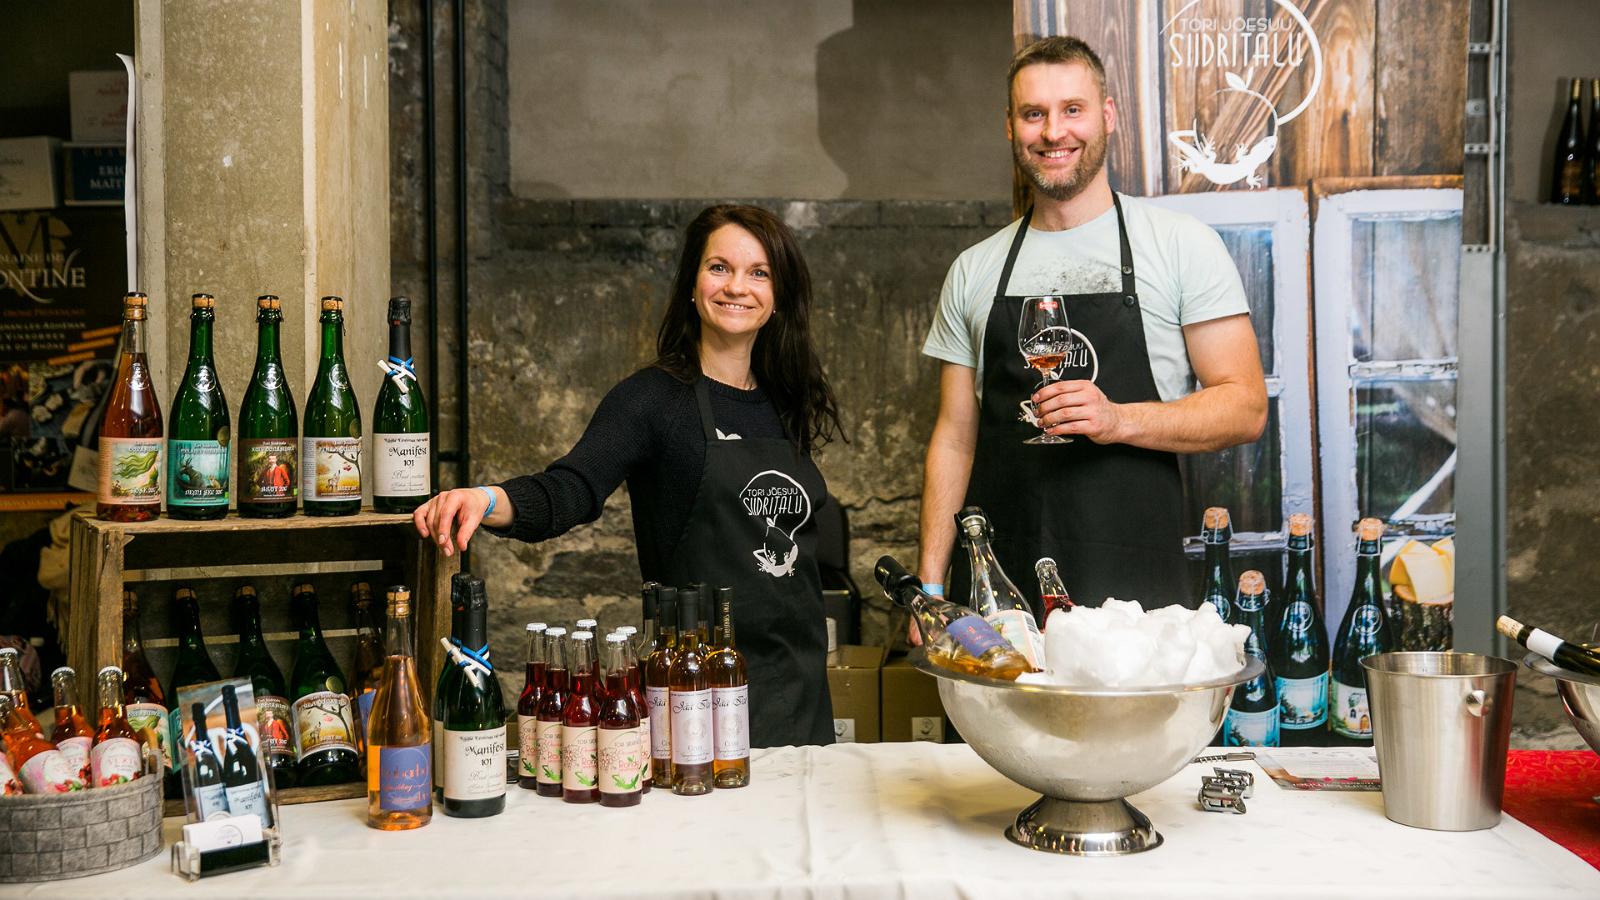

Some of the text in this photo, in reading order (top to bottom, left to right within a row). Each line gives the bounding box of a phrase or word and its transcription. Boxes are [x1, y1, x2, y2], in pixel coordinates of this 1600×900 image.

[1179, 18, 1217, 31] TORI
[1169, 32, 1303, 67] SIIDRITALU
[747, 486, 798, 498] TORI JÕESUU
[742, 495, 802, 516] SIIDRITALU
